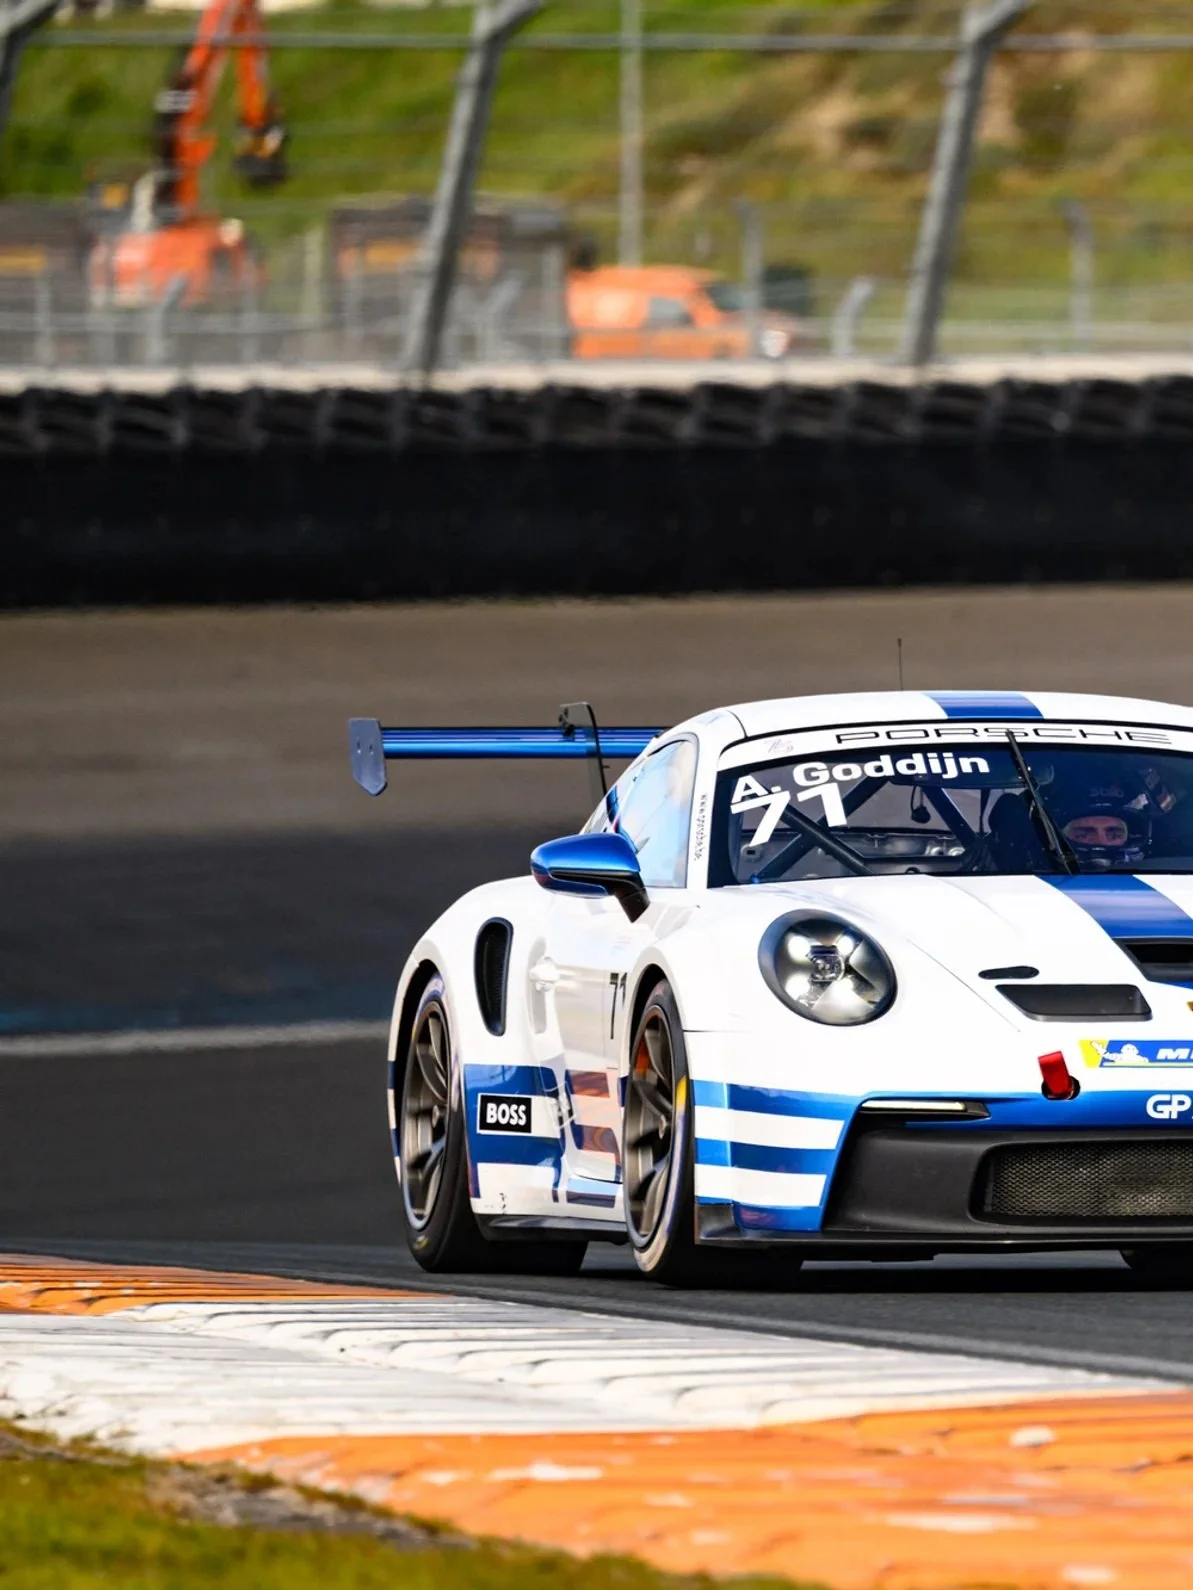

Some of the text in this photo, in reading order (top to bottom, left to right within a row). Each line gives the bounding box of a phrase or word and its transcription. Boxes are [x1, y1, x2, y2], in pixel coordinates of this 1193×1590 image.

[835, 727, 1172, 745] PORSCHE
[731, 752, 990, 805] A. Goddijn
[730, 782, 848, 848] 71
[610, 972, 628, 1040] 71
[486, 1102, 527, 1126] BOSS
